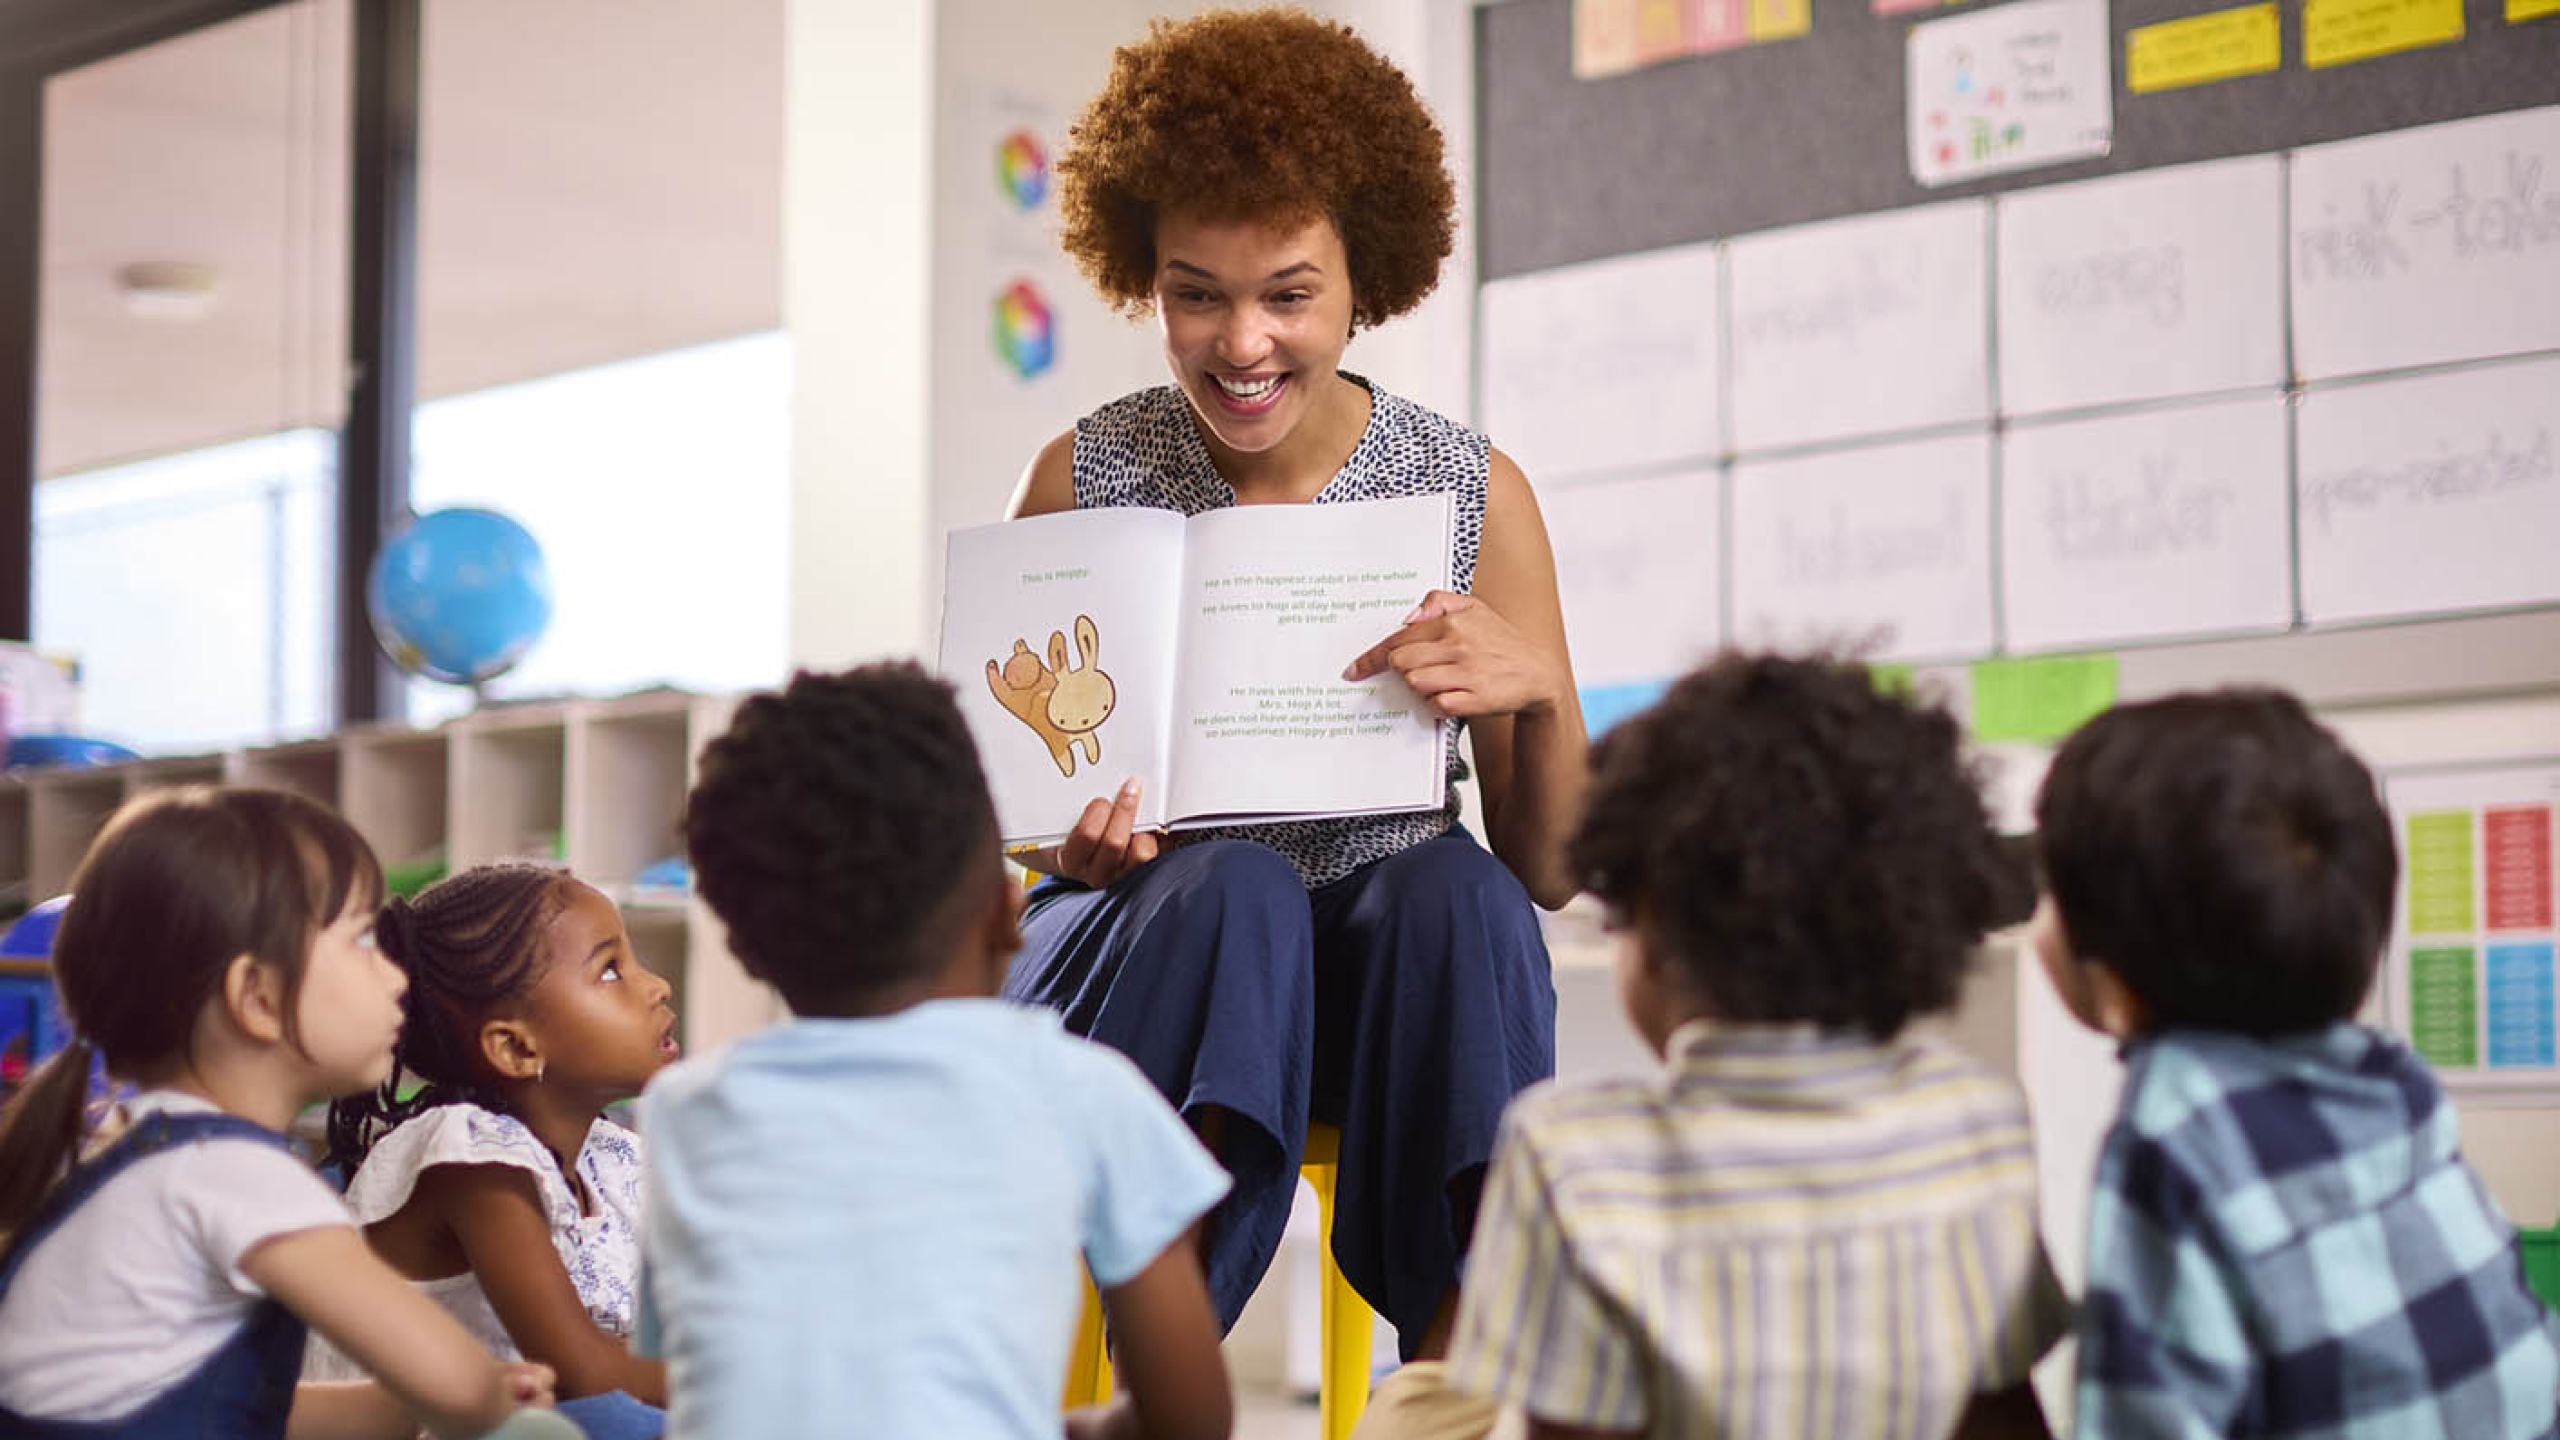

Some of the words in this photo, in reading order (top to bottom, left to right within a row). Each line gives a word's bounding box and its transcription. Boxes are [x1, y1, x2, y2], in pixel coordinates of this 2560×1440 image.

[1020, 569, 1043, 587] This
[1204, 577, 1219, 588] He
[1233, 575, 1253, 586] the
[1256, 575, 1306, 587] happiest
[1308, 573, 1344, 584] rabbit
[1346, 574, 1359, 583] in
[1361, 572, 1380, 582] the
[1382, 570, 1418, 581] whole
[1289, 587, 1327, 597] world.
[1202, 604, 1217, 615] He
[1265, 600, 1290, 612] hop
[1291, 599, 1305, 610] all
[1306, 599, 1329, 612] day
[1331, 600, 1357, 612] long
[1359, 598, 1381, 610] and
[1383, 598, 1415, 608] never
[1277, 614, 1303, 626] gets
[1230, 686, 1246, 697] He
[1248, 685, 1275, 697] lives
[1277, 685, 1305, 697] with
[1306, 685, 1324, 696] his
[1287, 699, 1312, 712] Hop
[1315, 699, 1324, 710] A
[1193, 716, 1209, 726] He
[1210, 713, 1237, 726] does
[1238, 713, 1258, 724] not
[1259, 712, 1287, 724] have
[1289, 713, 1311, 726] any
[1313, 711, 1356, 724] brother
[1358, 712, 1372, 722] or
[1220, 726, 1286, 738] sometimes
[1287, 726, 1327, 740] Hoppy
[1328, 726, 1355, 739] gets
